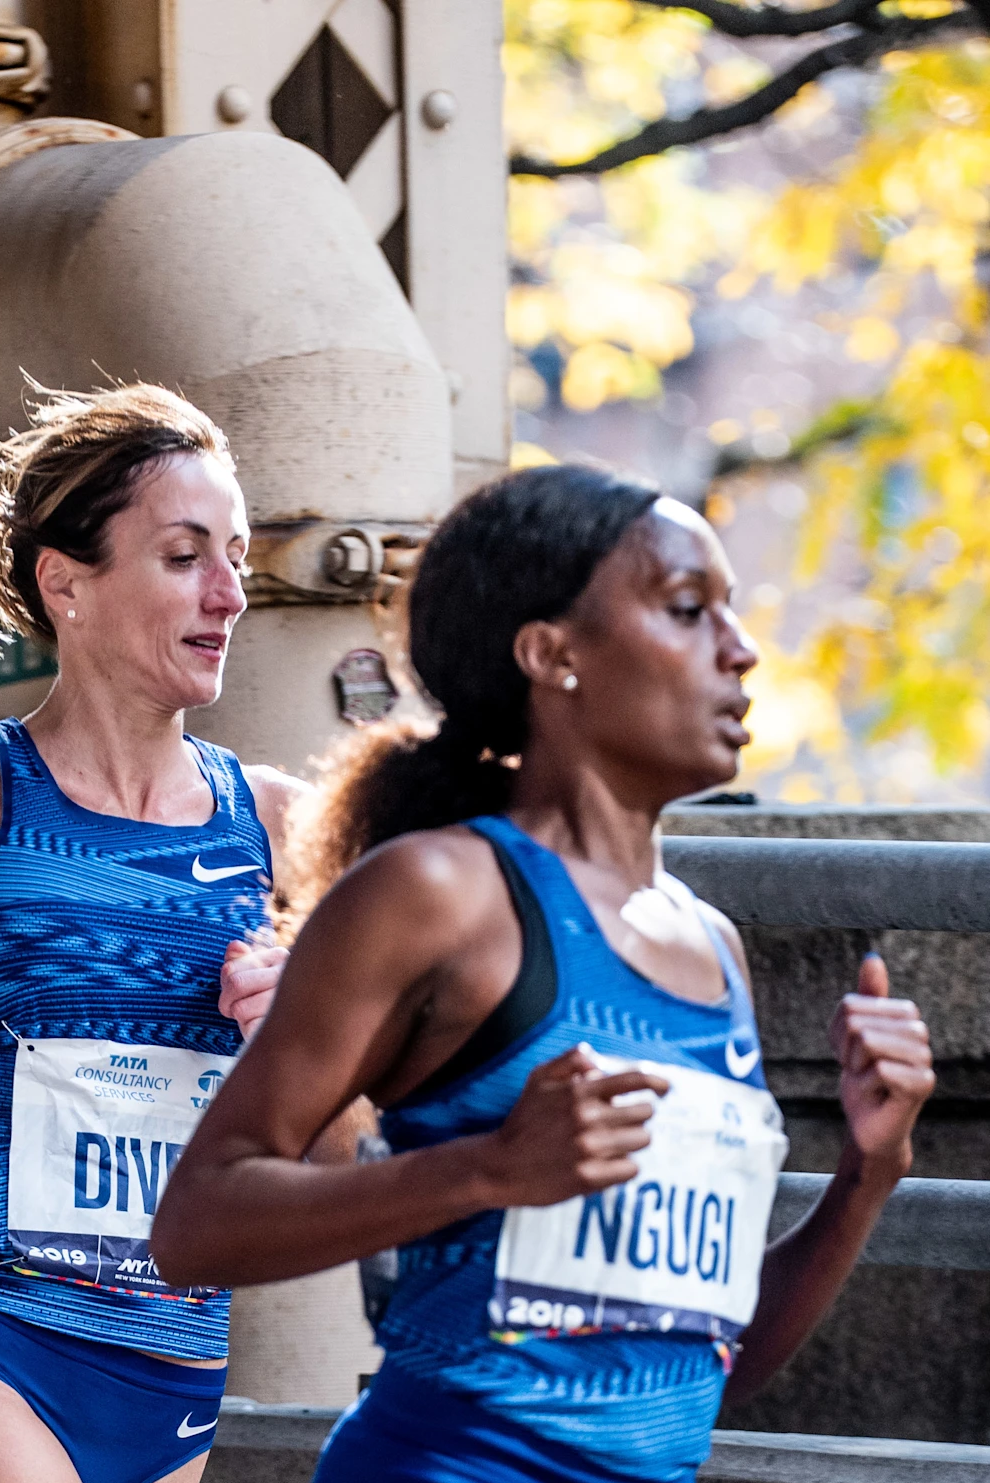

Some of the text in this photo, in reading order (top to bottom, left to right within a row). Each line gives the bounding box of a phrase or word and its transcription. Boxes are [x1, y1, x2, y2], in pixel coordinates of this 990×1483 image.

[110, 1055, 148, 1071] TATA
[75, 1066, 173, 1091] CONSULTANCY
[94, 1085, 156, 1103] SERVICES
[74, 1131, 187, 1215] DIV
[573, 1181, 735, 1286] NGUGI
[28, 1245, 88, 1266] 2019
[505, 1296, 586, 1330] 2019
